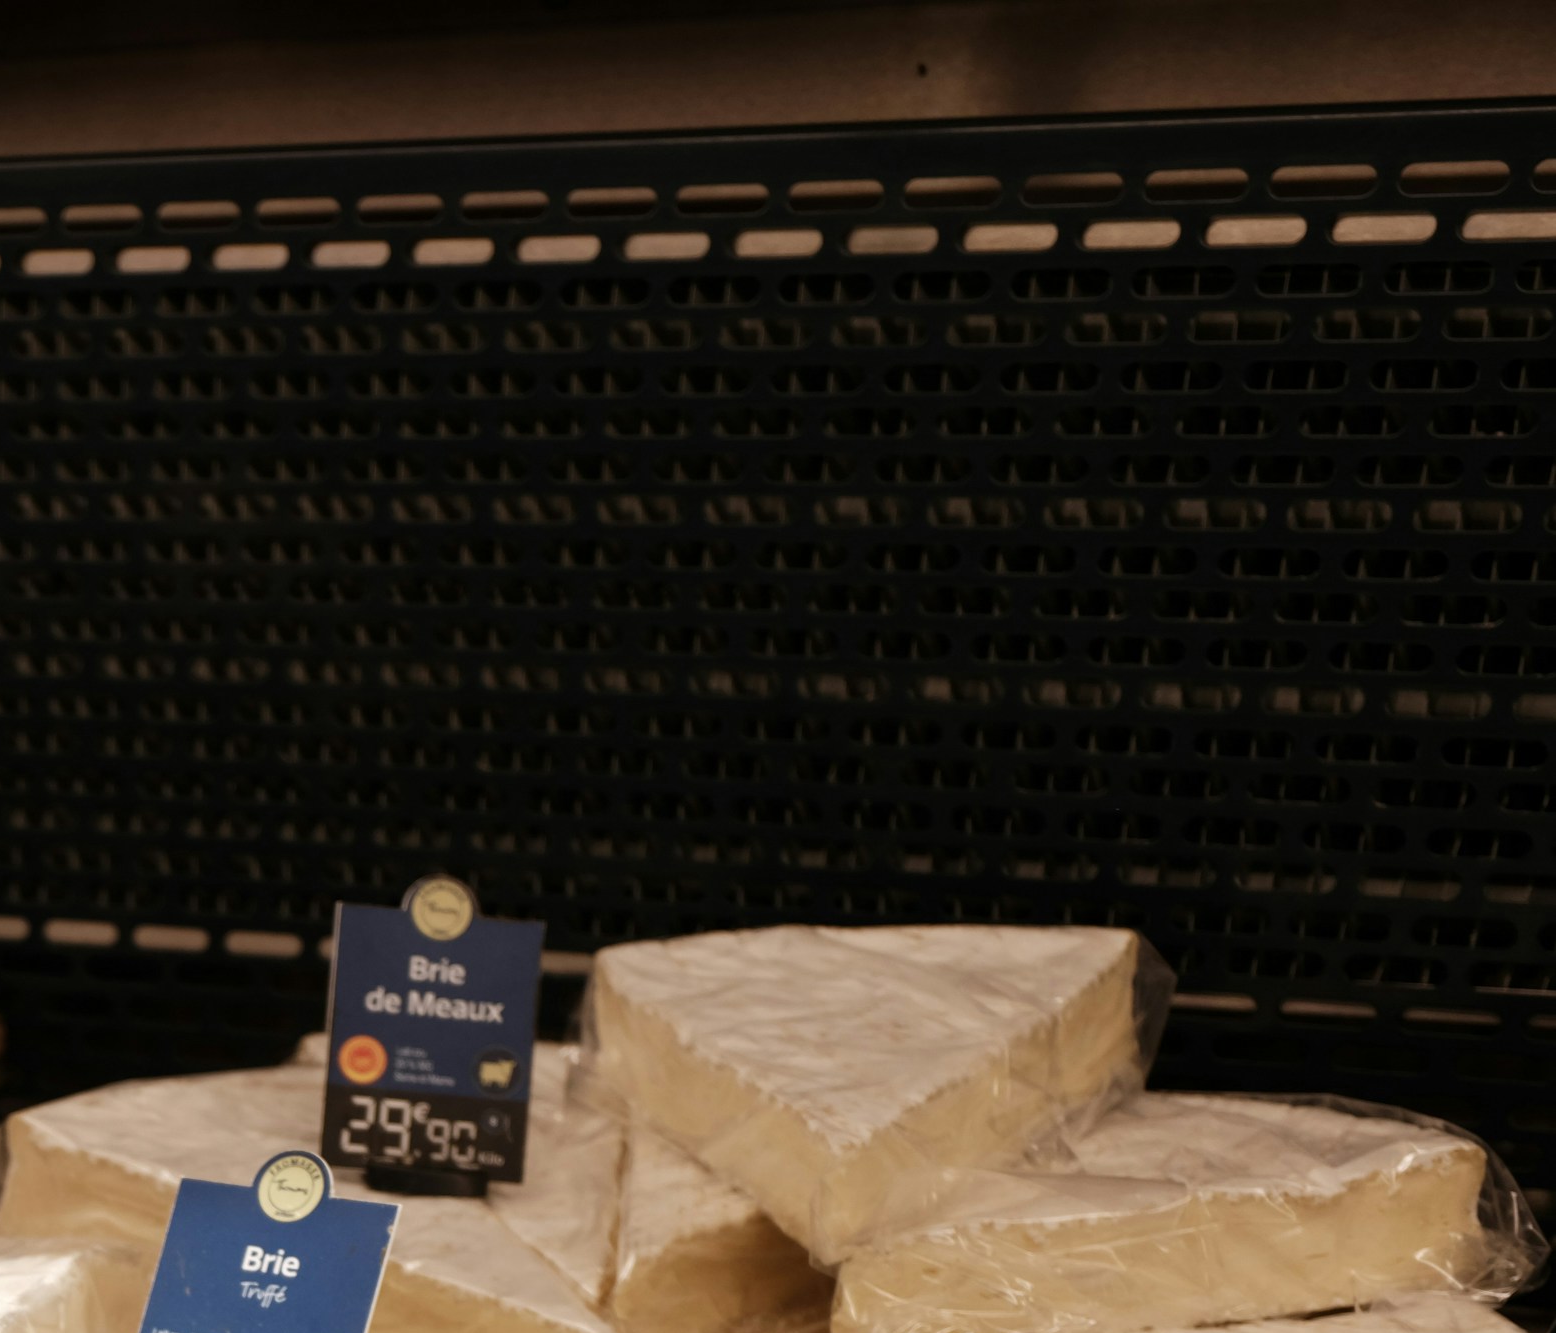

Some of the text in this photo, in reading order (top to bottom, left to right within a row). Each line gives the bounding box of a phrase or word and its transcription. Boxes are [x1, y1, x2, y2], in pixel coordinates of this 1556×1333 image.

[408, 954, 466, 986] Brie
[364, 986, 505, 1024] de Meaux
[241, 1245, 300, 1278] Brie
[240, 1281, 287, 1308] Truffé
